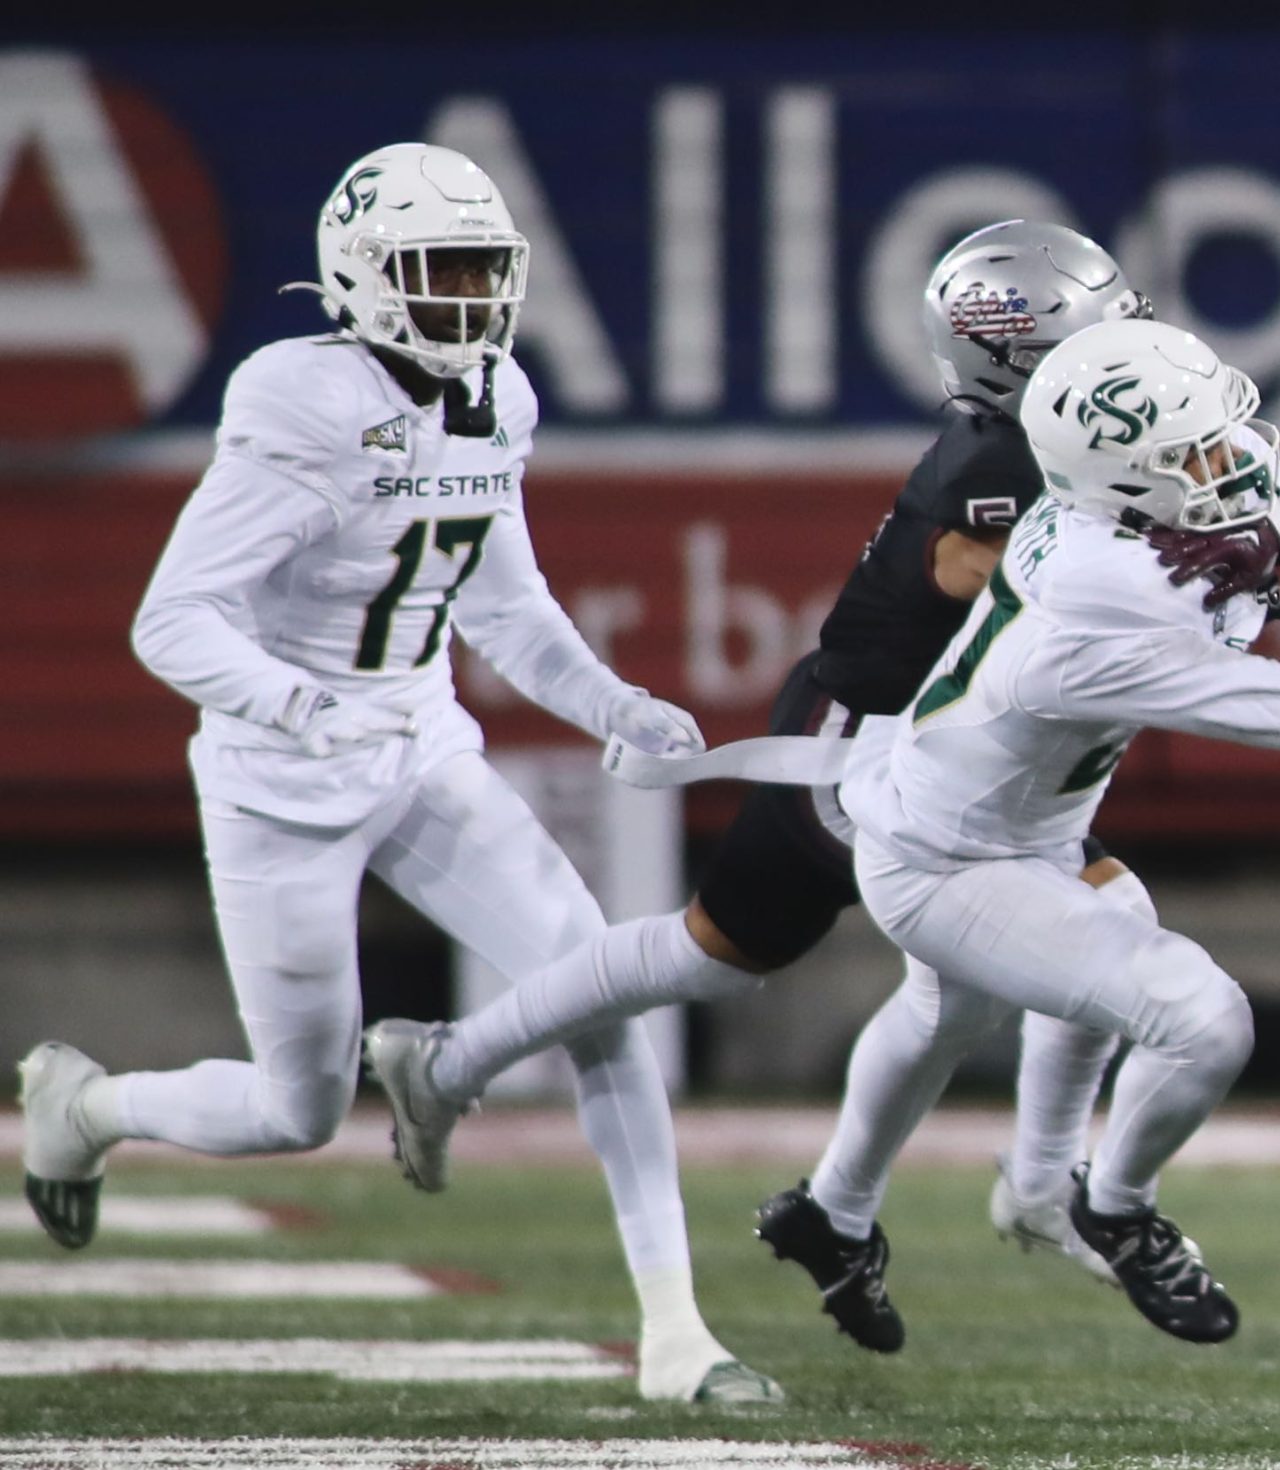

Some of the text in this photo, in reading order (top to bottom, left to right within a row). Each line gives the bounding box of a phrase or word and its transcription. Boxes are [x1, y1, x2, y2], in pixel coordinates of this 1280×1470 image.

[374, 472, 512, 497] SAC STATE
[353, 513, 496, 672] 17
